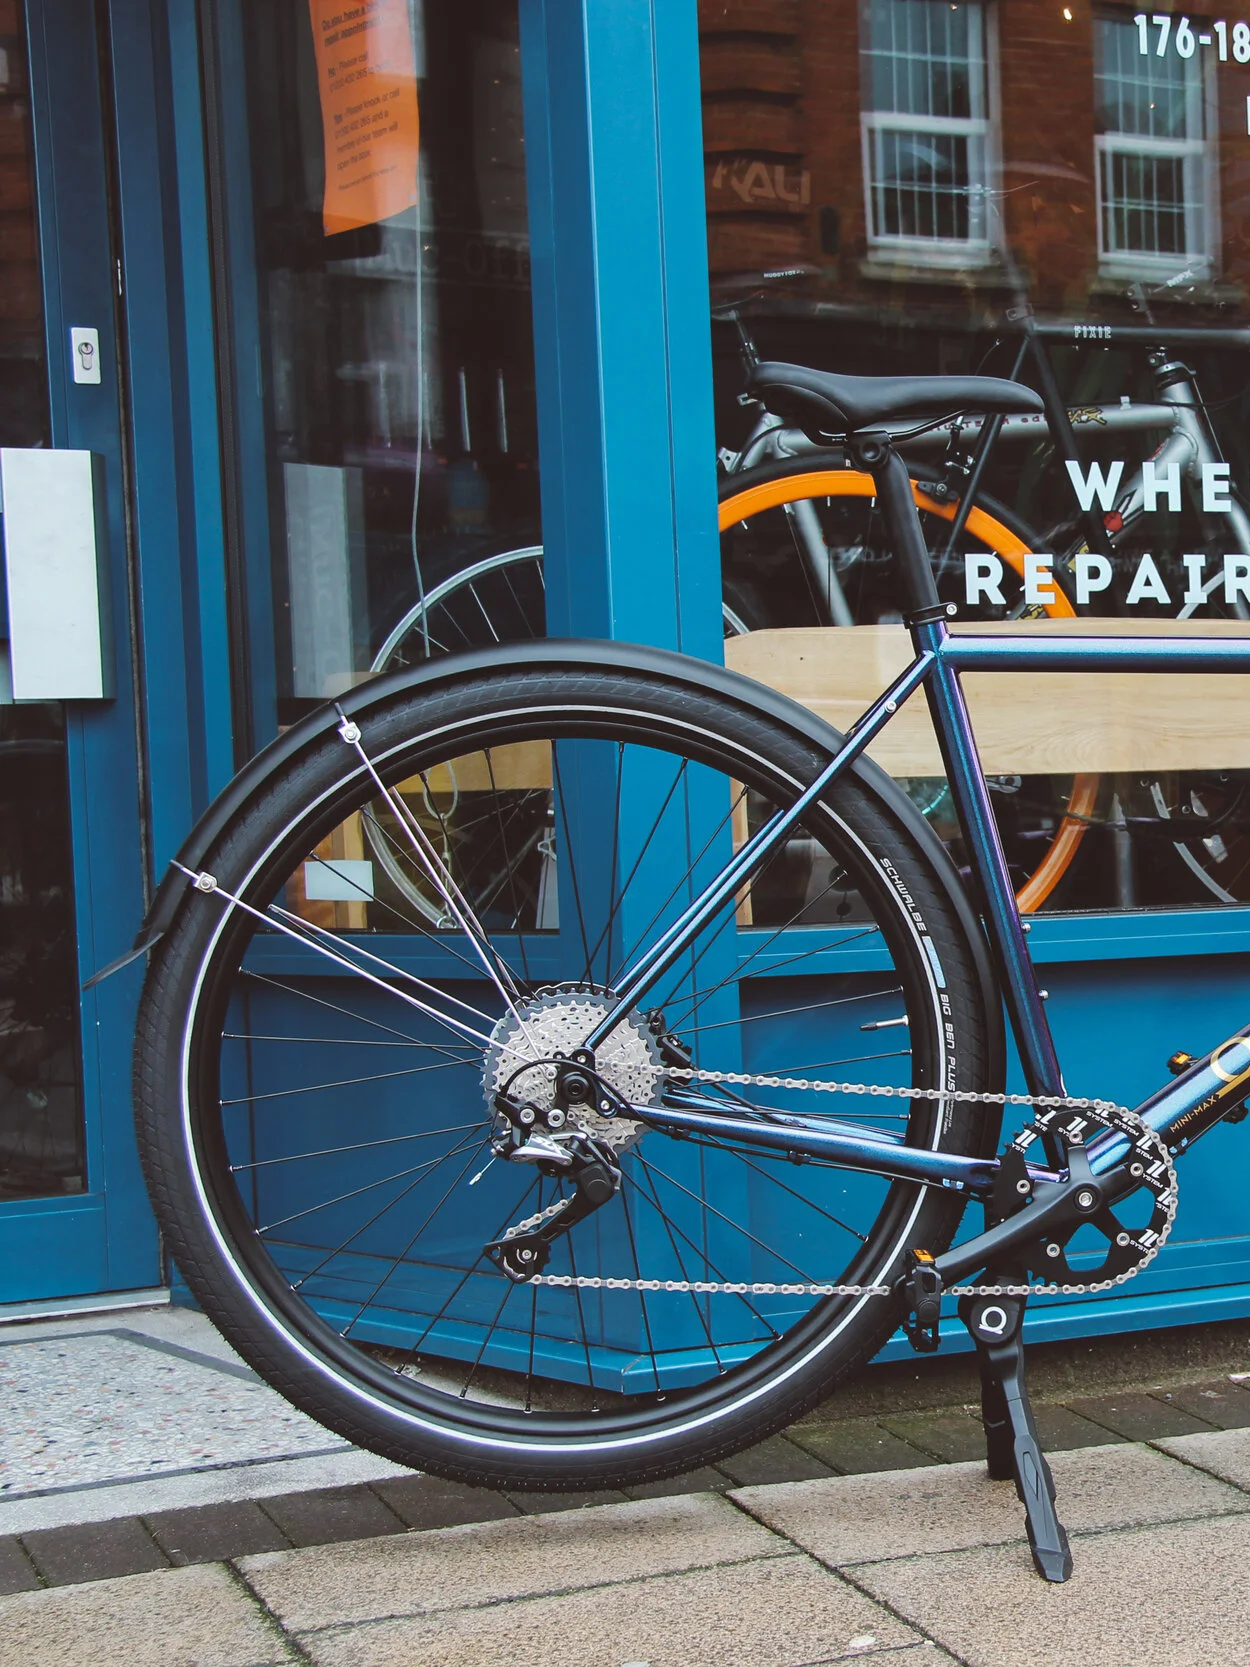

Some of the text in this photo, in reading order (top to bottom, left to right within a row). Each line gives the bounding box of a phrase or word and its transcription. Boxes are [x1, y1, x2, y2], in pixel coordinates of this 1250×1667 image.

[1074, 326, 1111, 339] FIXIE
[880, 857, 927, 932] SCHWALBE
[940, 993, 952, 1016] BIG
[947, 1055, 956, 1092] PLUS
[1170, 1095, 1217, 1133] MINI-MAX
